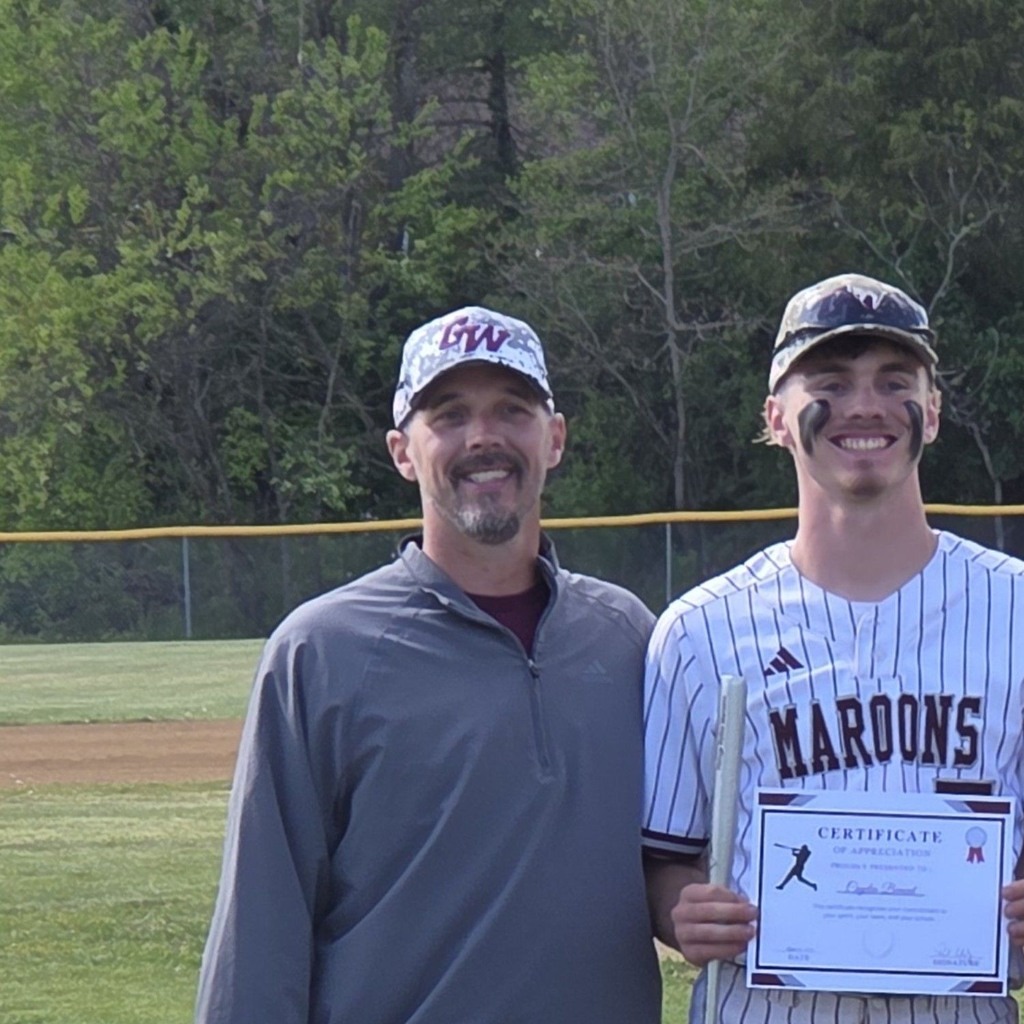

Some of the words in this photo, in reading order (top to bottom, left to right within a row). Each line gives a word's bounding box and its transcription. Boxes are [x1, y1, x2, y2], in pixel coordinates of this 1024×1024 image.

[439, 316, 510, 353] GW
[769, 693, 983, 780] MAROONS
[817, 826, 943, 844] CERTIFICATE
[832, 846, 847, 854] OF
[850, 847, 932, 858] APPRECIATION
